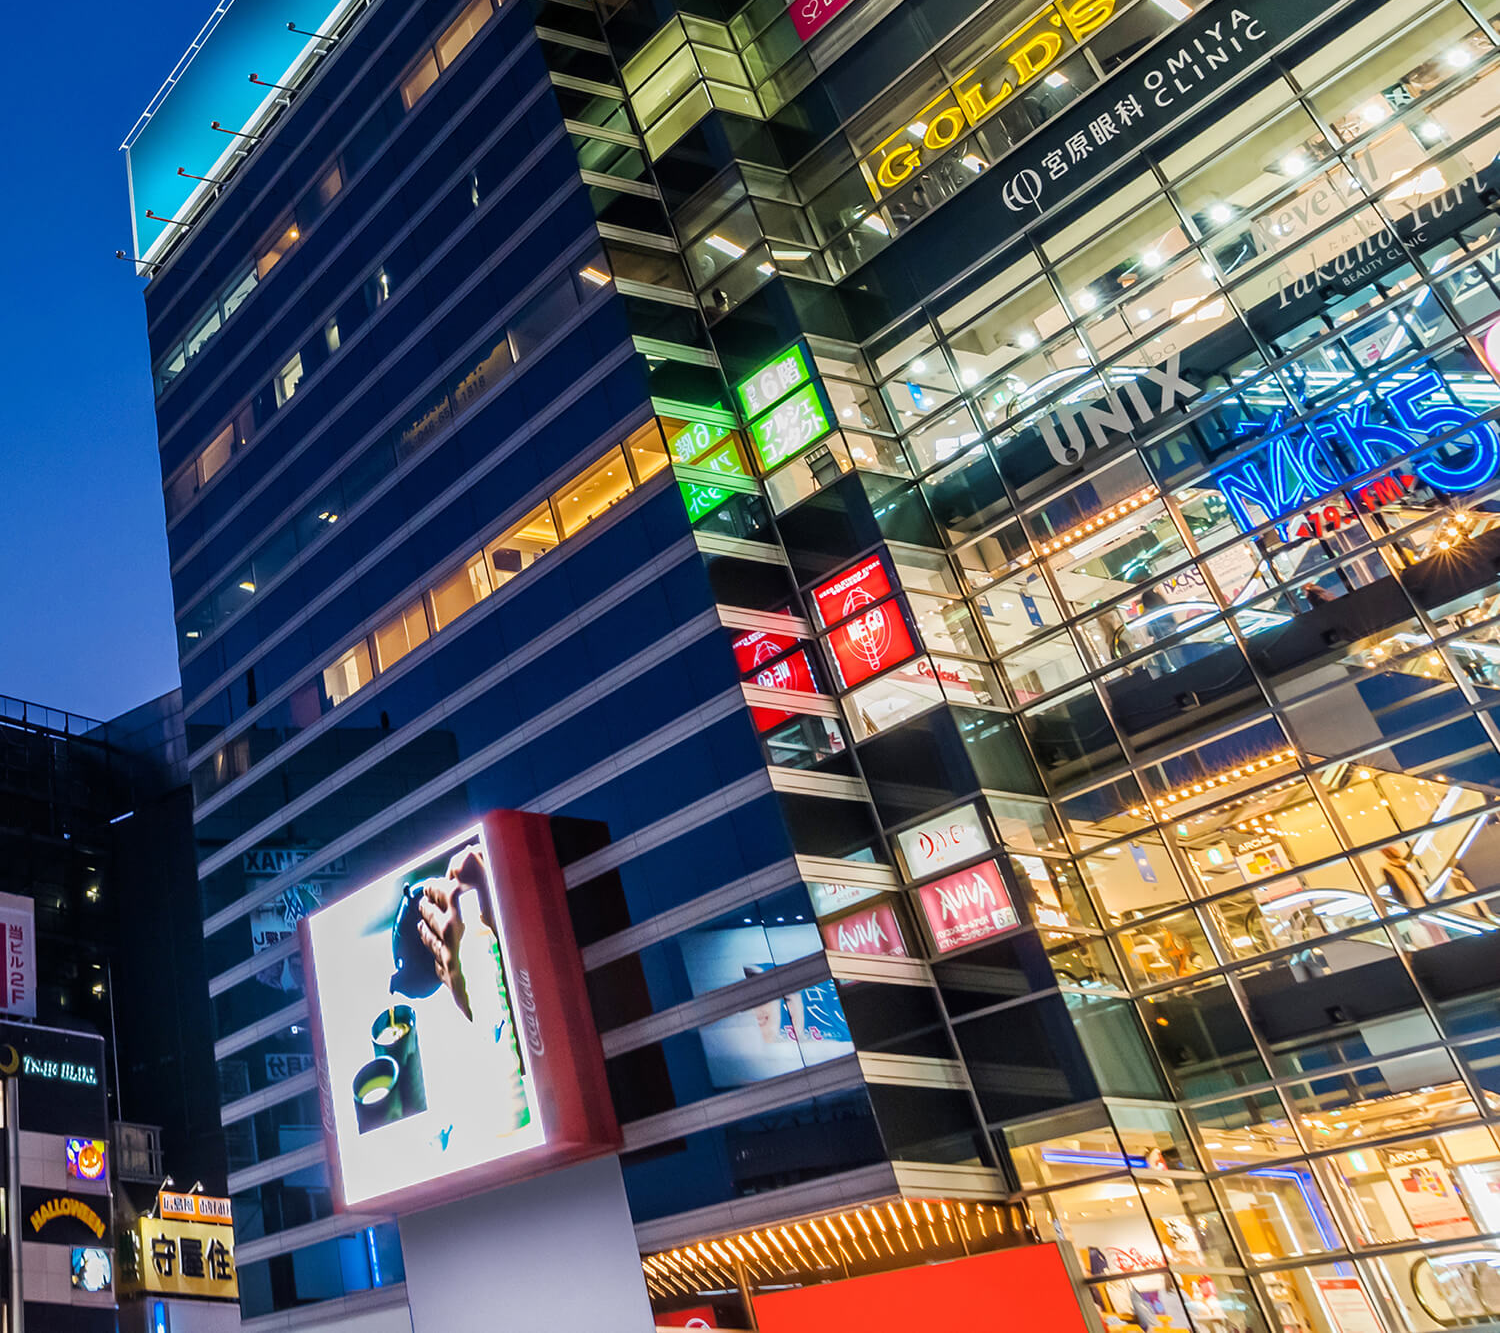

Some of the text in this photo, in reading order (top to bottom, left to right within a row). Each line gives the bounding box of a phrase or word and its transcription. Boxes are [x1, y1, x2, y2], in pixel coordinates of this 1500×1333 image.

[1143, 9, 1251, 90] OMIYA
[1154, 20, 1266, 107] CLINIC
[1041, 94, 1145, 181] 宮原眼科
[1268, 230, 1394, 310] Takano
[1400, 163, 1488, 233] Yuri
[1342, 231, 1428, 287] BEAUTY CLNIC
[759, 356, 801, 400] 6階
[1036, 351, 1203, 467] UNIX
[1217, 369, 1500, 534] NACK5
[1360, 475, 1405, 512] FM
[1238, 834, 1273, 853] ARCHE
[29, 1197, 107, 1240] HALLOWEEN
[151, 1233, 236, 1280] 守屋住
